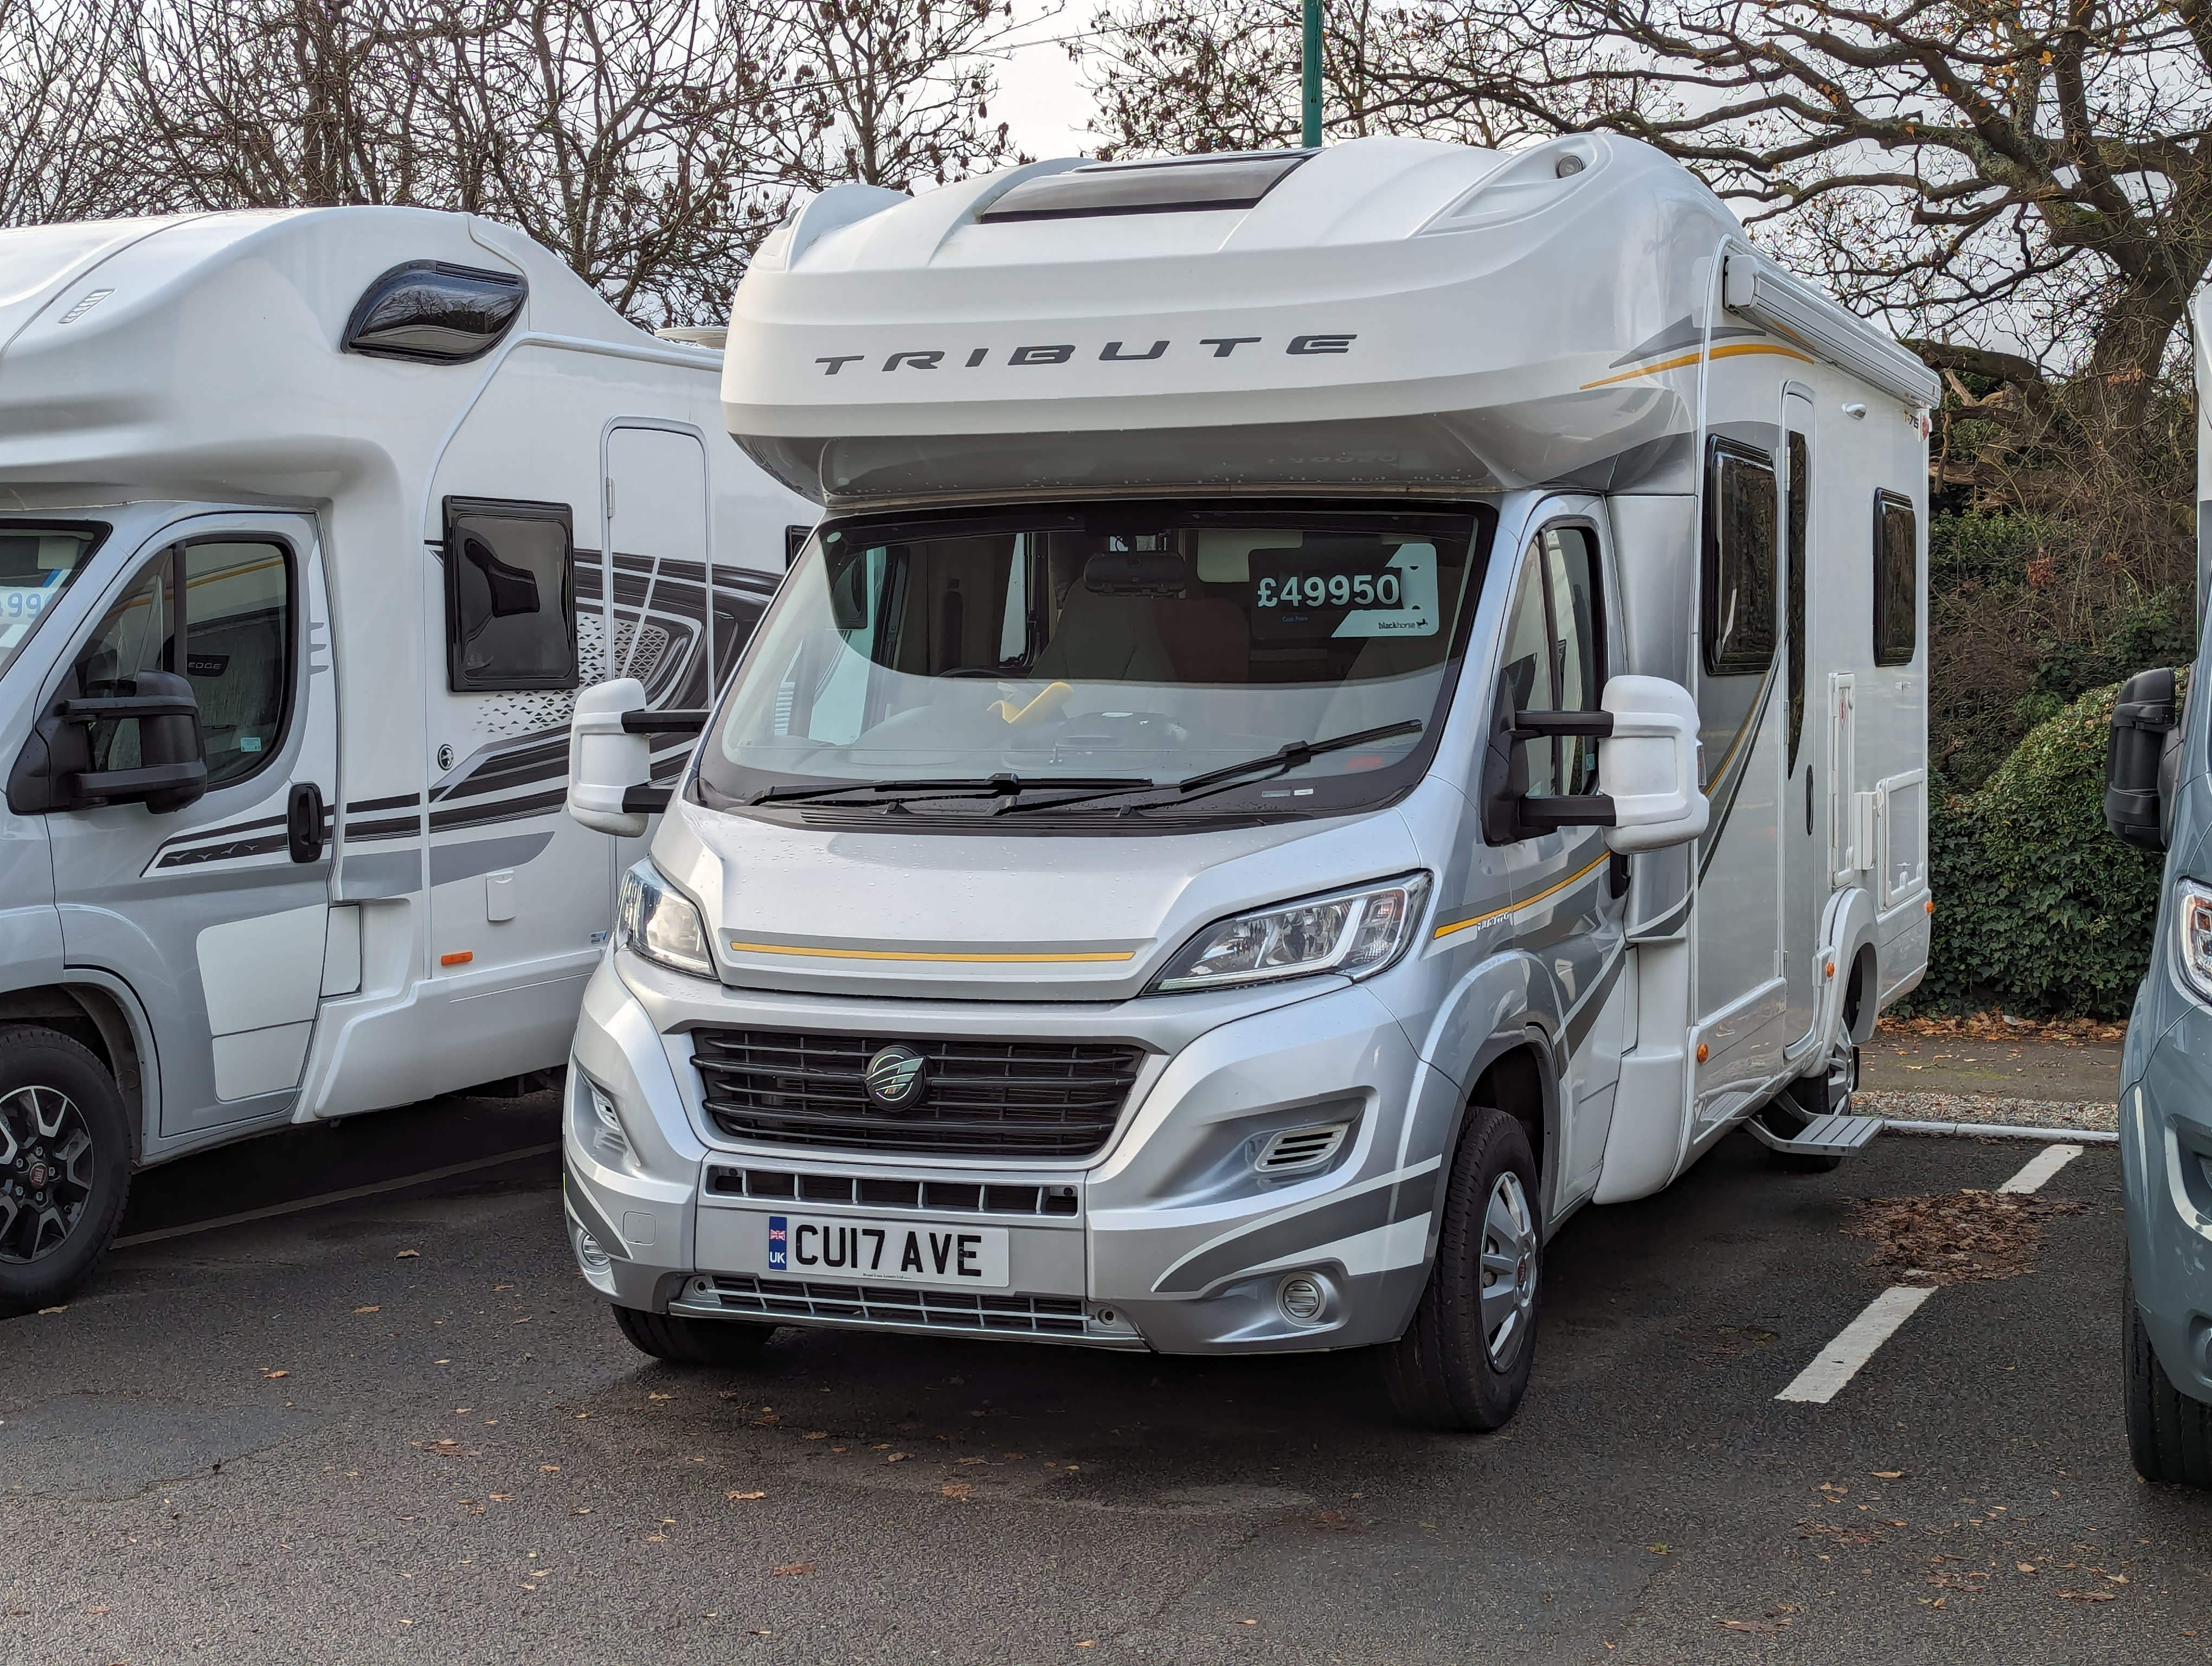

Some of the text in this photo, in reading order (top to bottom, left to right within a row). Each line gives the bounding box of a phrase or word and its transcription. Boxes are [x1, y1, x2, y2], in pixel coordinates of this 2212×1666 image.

[814, 334, 1358, 375] TRIBUTE
[0, 592, 54, 619] 99
[1257, 574, 1399, 607] £49950
[770, 1251, 786, 1264] UK
[795, 1224, 982, 1278] CU17 AVE
